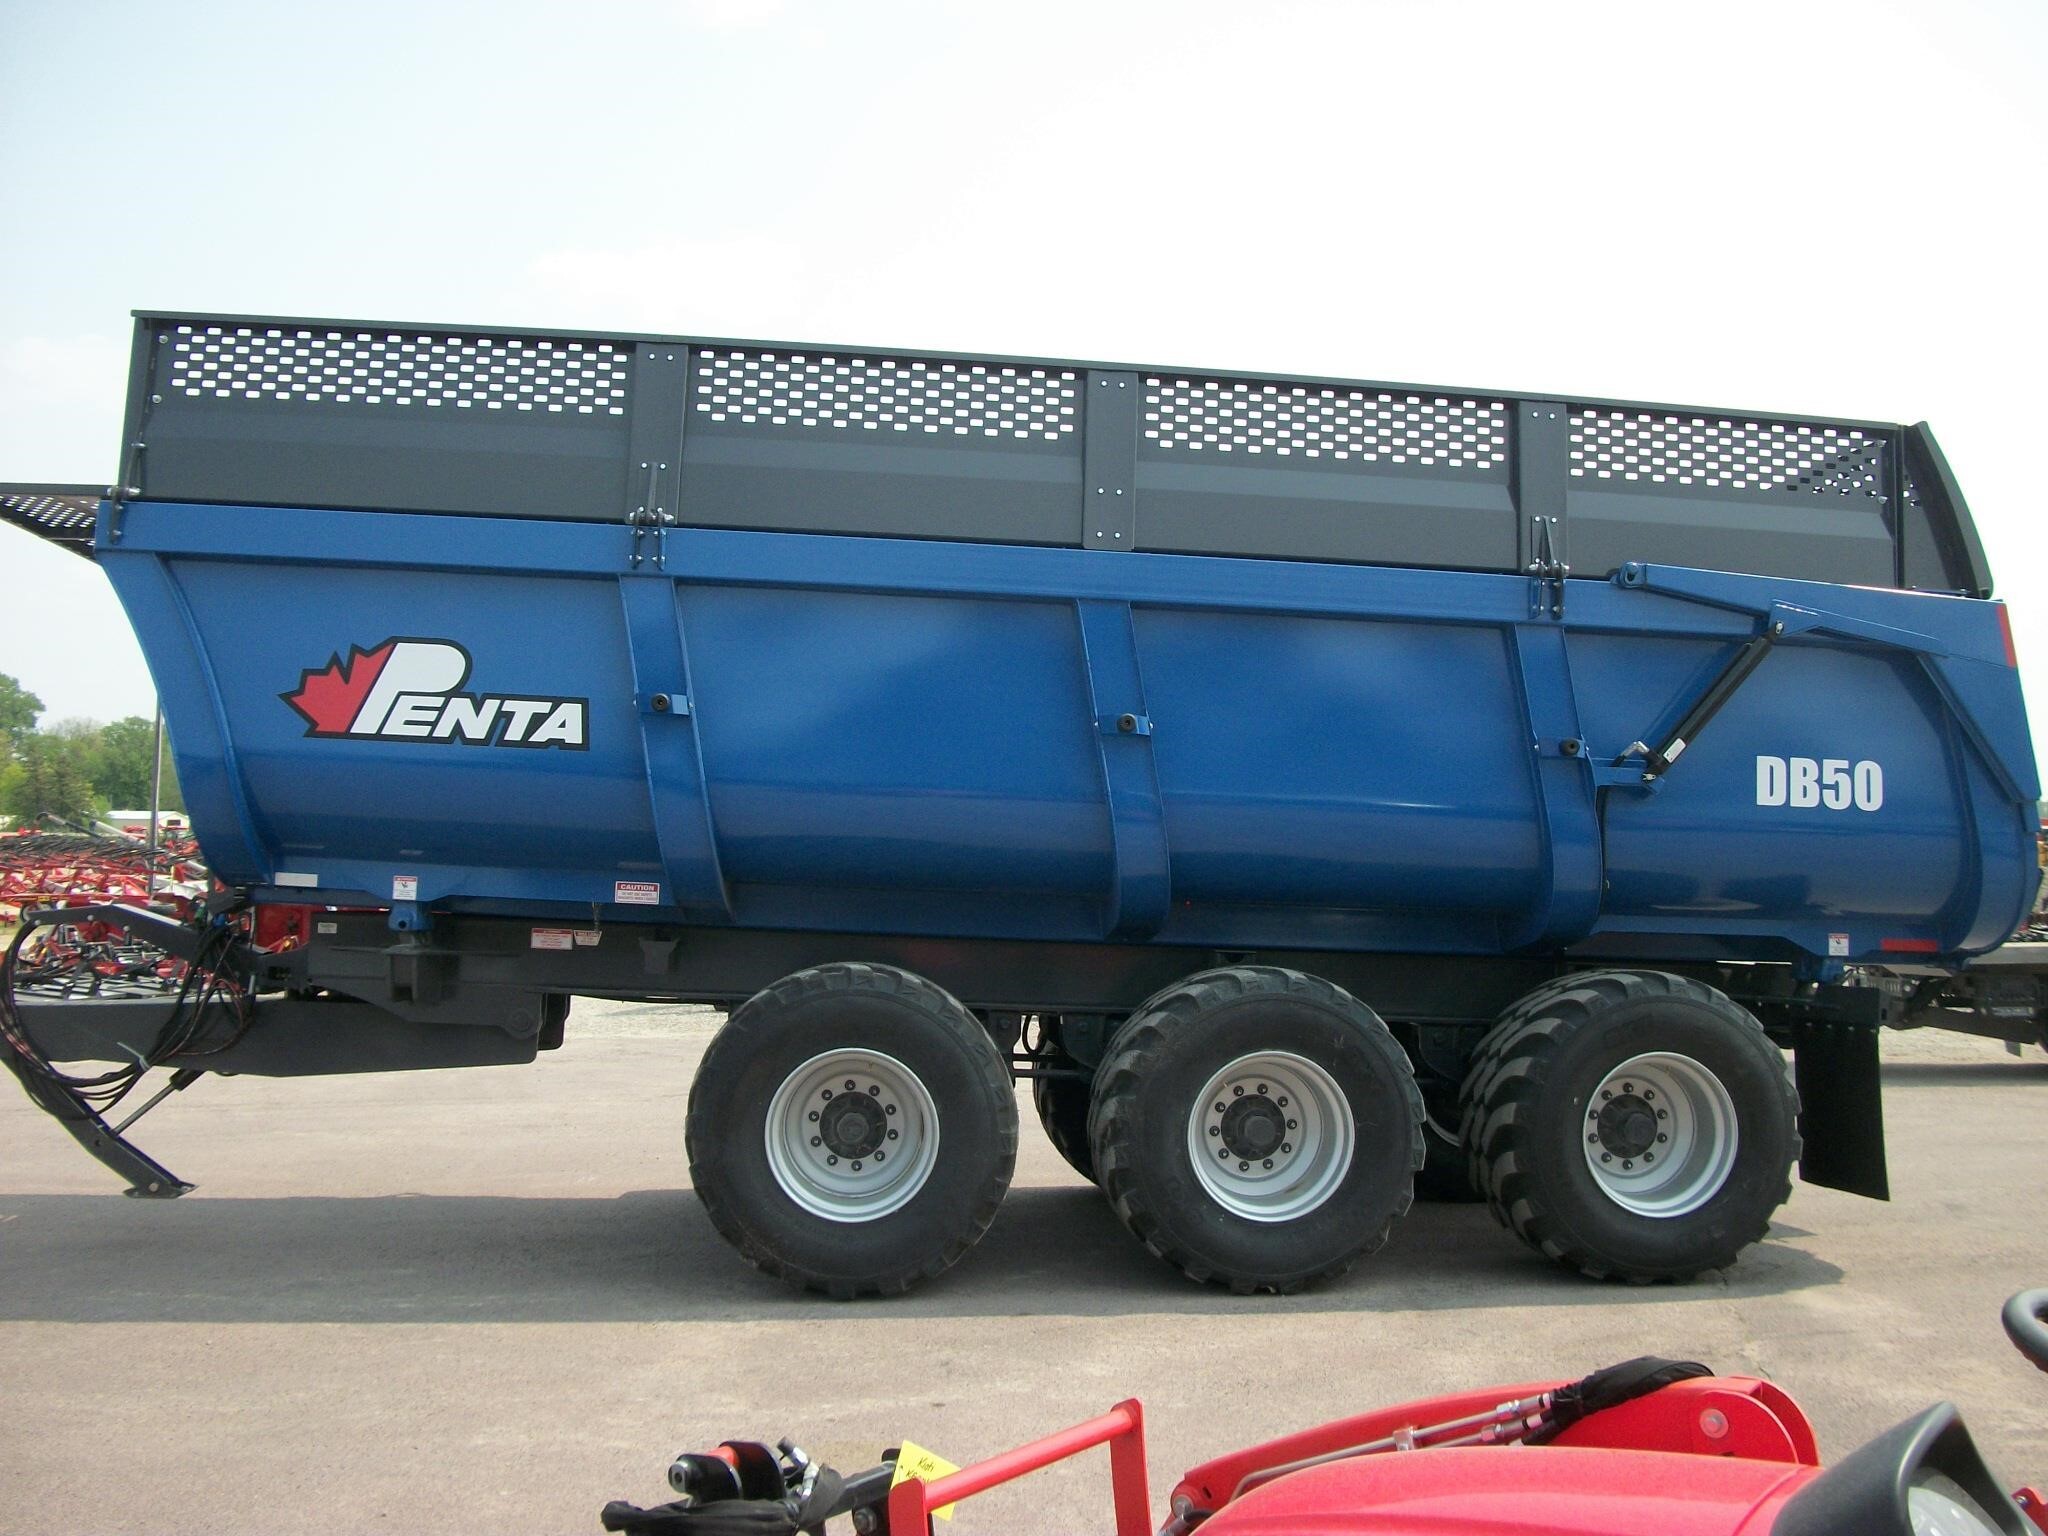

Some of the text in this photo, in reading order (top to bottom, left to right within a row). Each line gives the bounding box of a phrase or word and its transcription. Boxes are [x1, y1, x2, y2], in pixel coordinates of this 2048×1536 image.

[349, 642, 582, 744] PENTA
[1756, 755, 1883, 812] DB50
[620, 883, 656, 891] CAUTION
